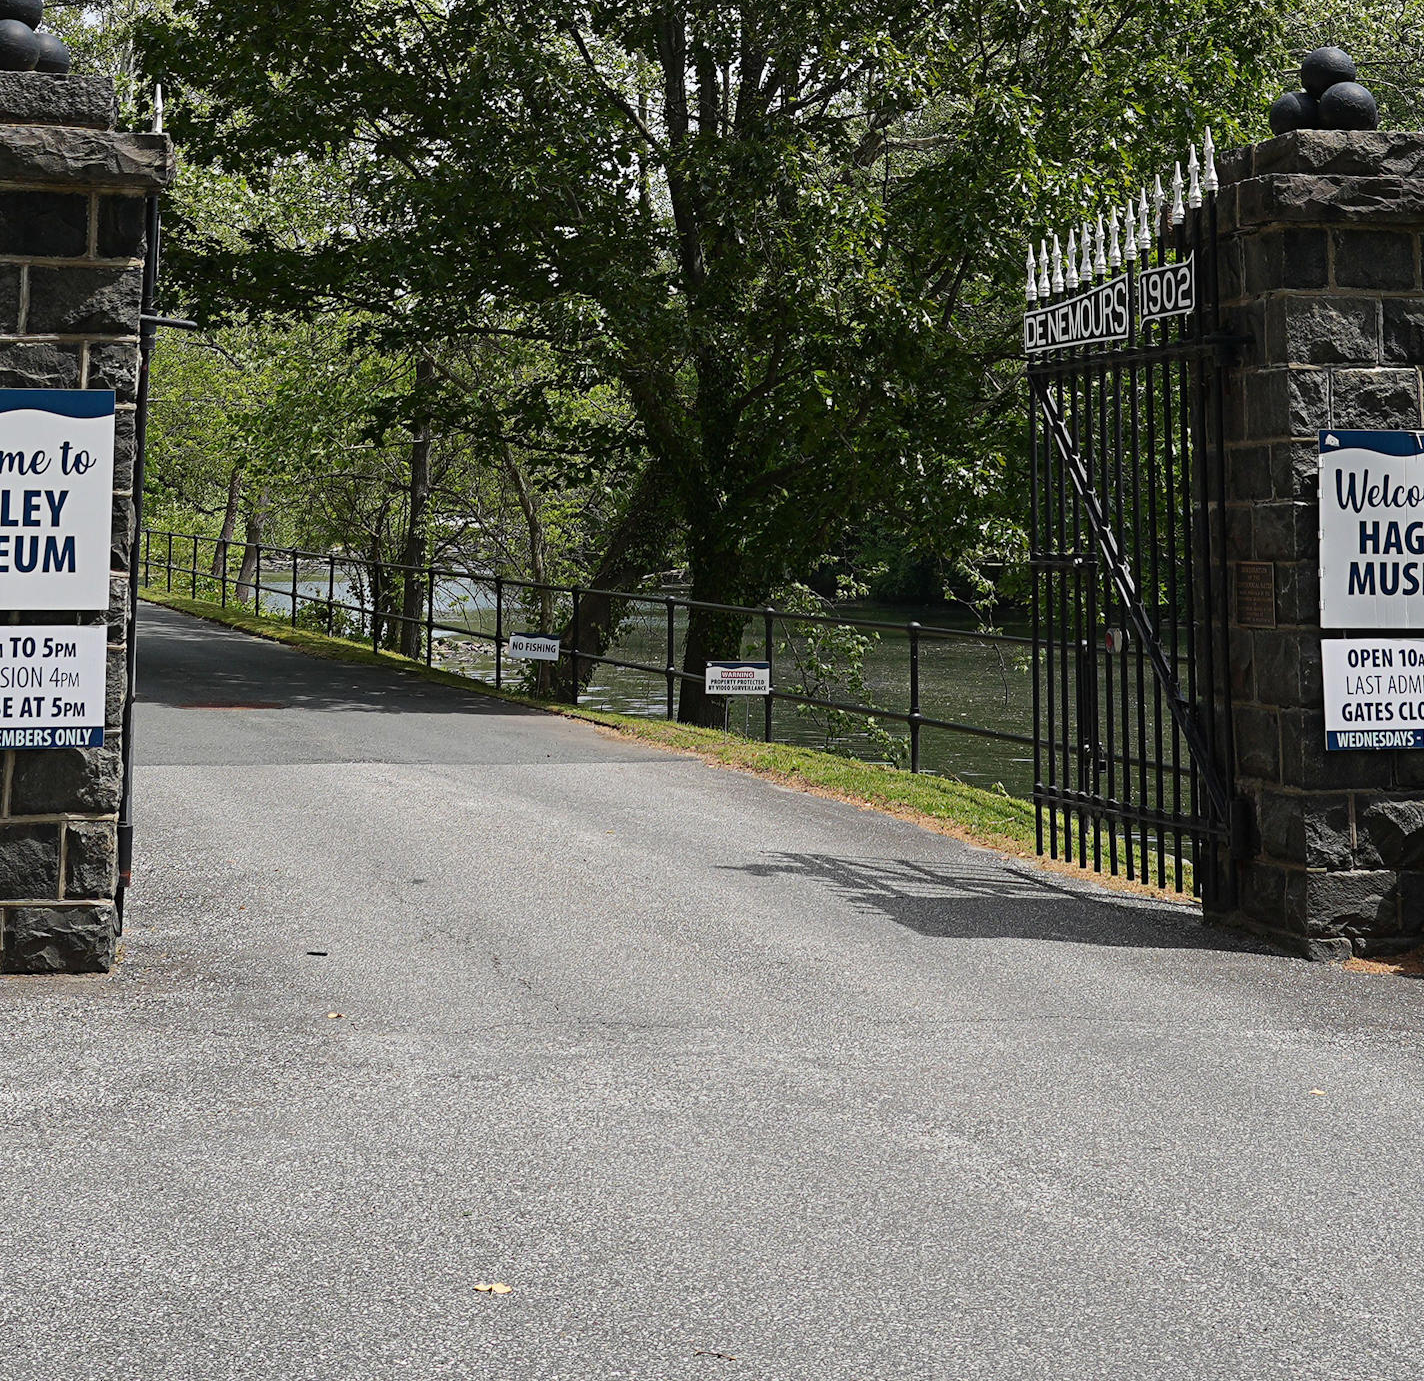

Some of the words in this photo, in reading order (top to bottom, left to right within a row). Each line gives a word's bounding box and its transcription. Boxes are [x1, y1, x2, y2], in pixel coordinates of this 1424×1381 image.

[1142, 266, 1191, 315] 1902
[1026, 314, 1046, 348] DE
[1048, 282, 1126, 344] NEMOURS
[60, 441, 97, 476] to
[10, 637, 36, 658] TO
[512, 642, 523, 650] NO
[526, 643, 556, 653] FISHING
[1348, 648, 1393, 668] OPEN
[1347, 676, 1382, 694] LAST
[19, 697, 45, 718] AT
[1342, 702, 1394, 722] GATES
[55, 729, 93, 746] ONLY
[1337, 731, 1414, 747] WEDNESDAYS
